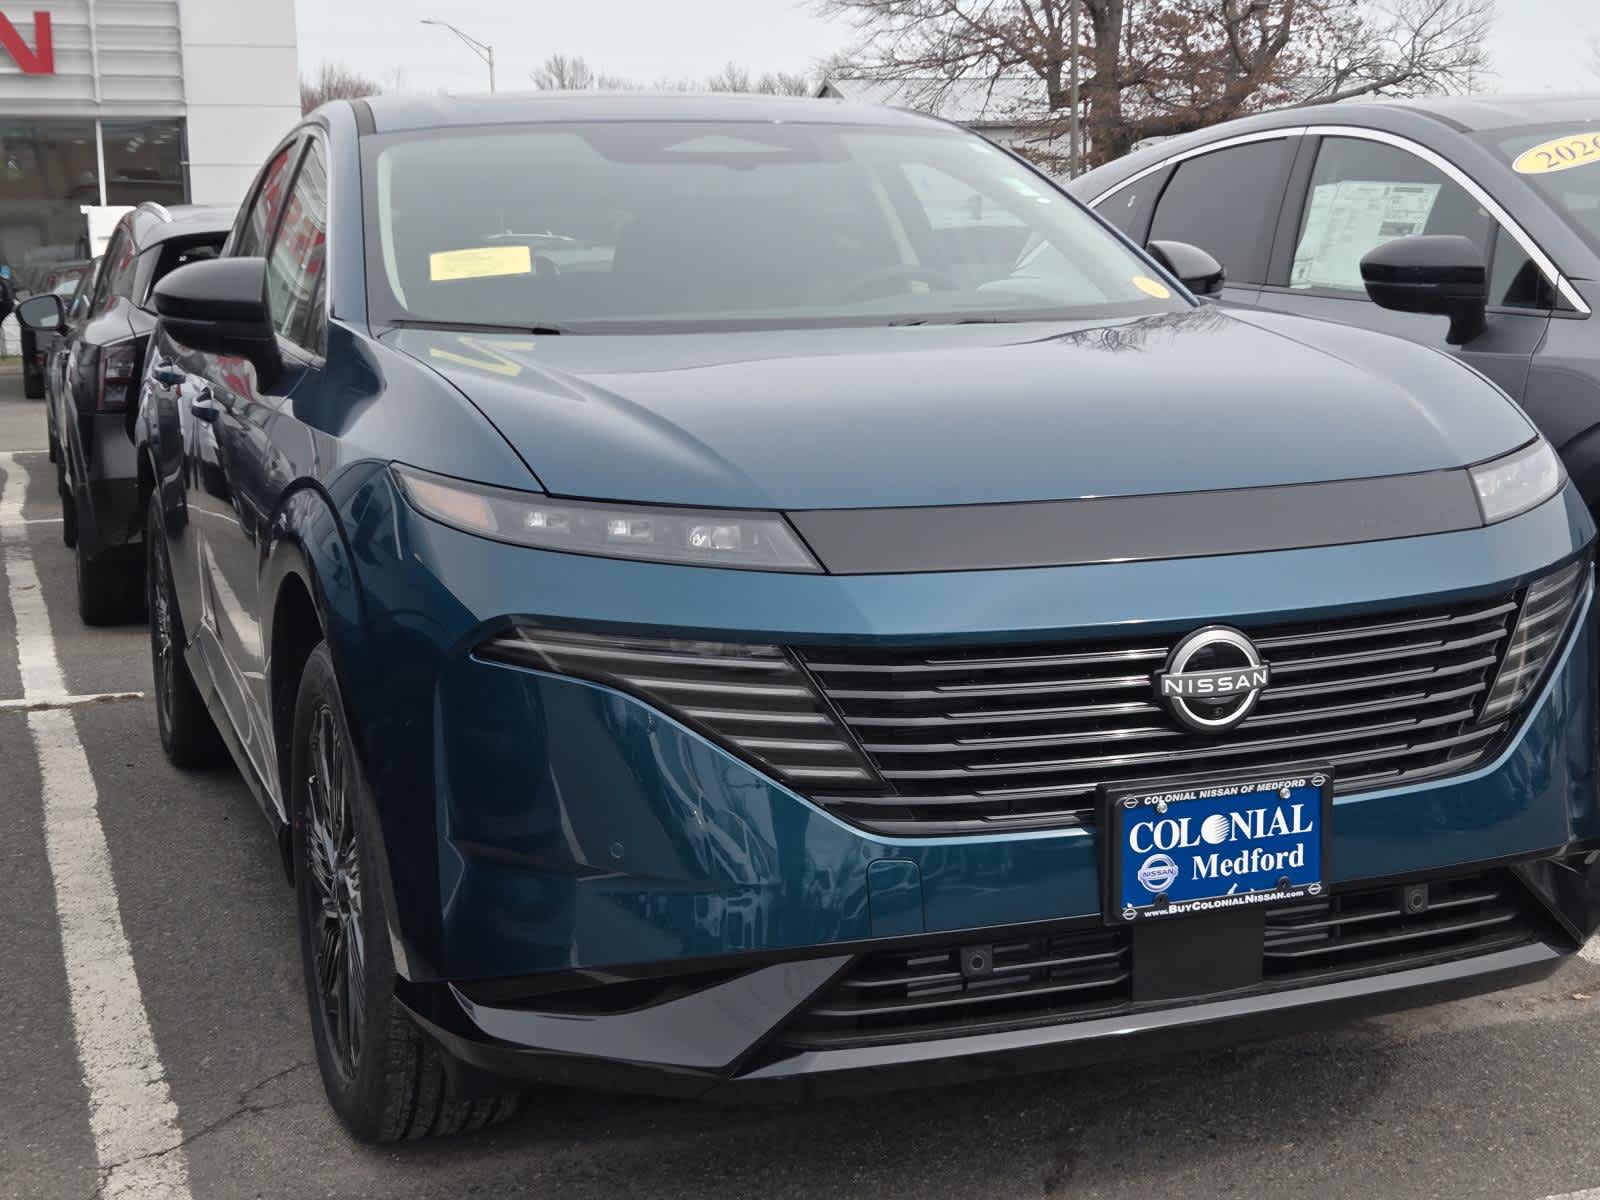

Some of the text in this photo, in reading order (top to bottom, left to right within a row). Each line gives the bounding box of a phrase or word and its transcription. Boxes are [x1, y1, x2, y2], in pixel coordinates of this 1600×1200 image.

[1165, 669, 1267, 694] NISSAN
[1144, 779, 1306, 805] COLONIAL NISSAN OF MEDFORD
[1129, 803, 1313, 854] COLONIAL
[1143, 868, 1173, 878] NISSAN
[1192, 842, 1305, 881] Medford
